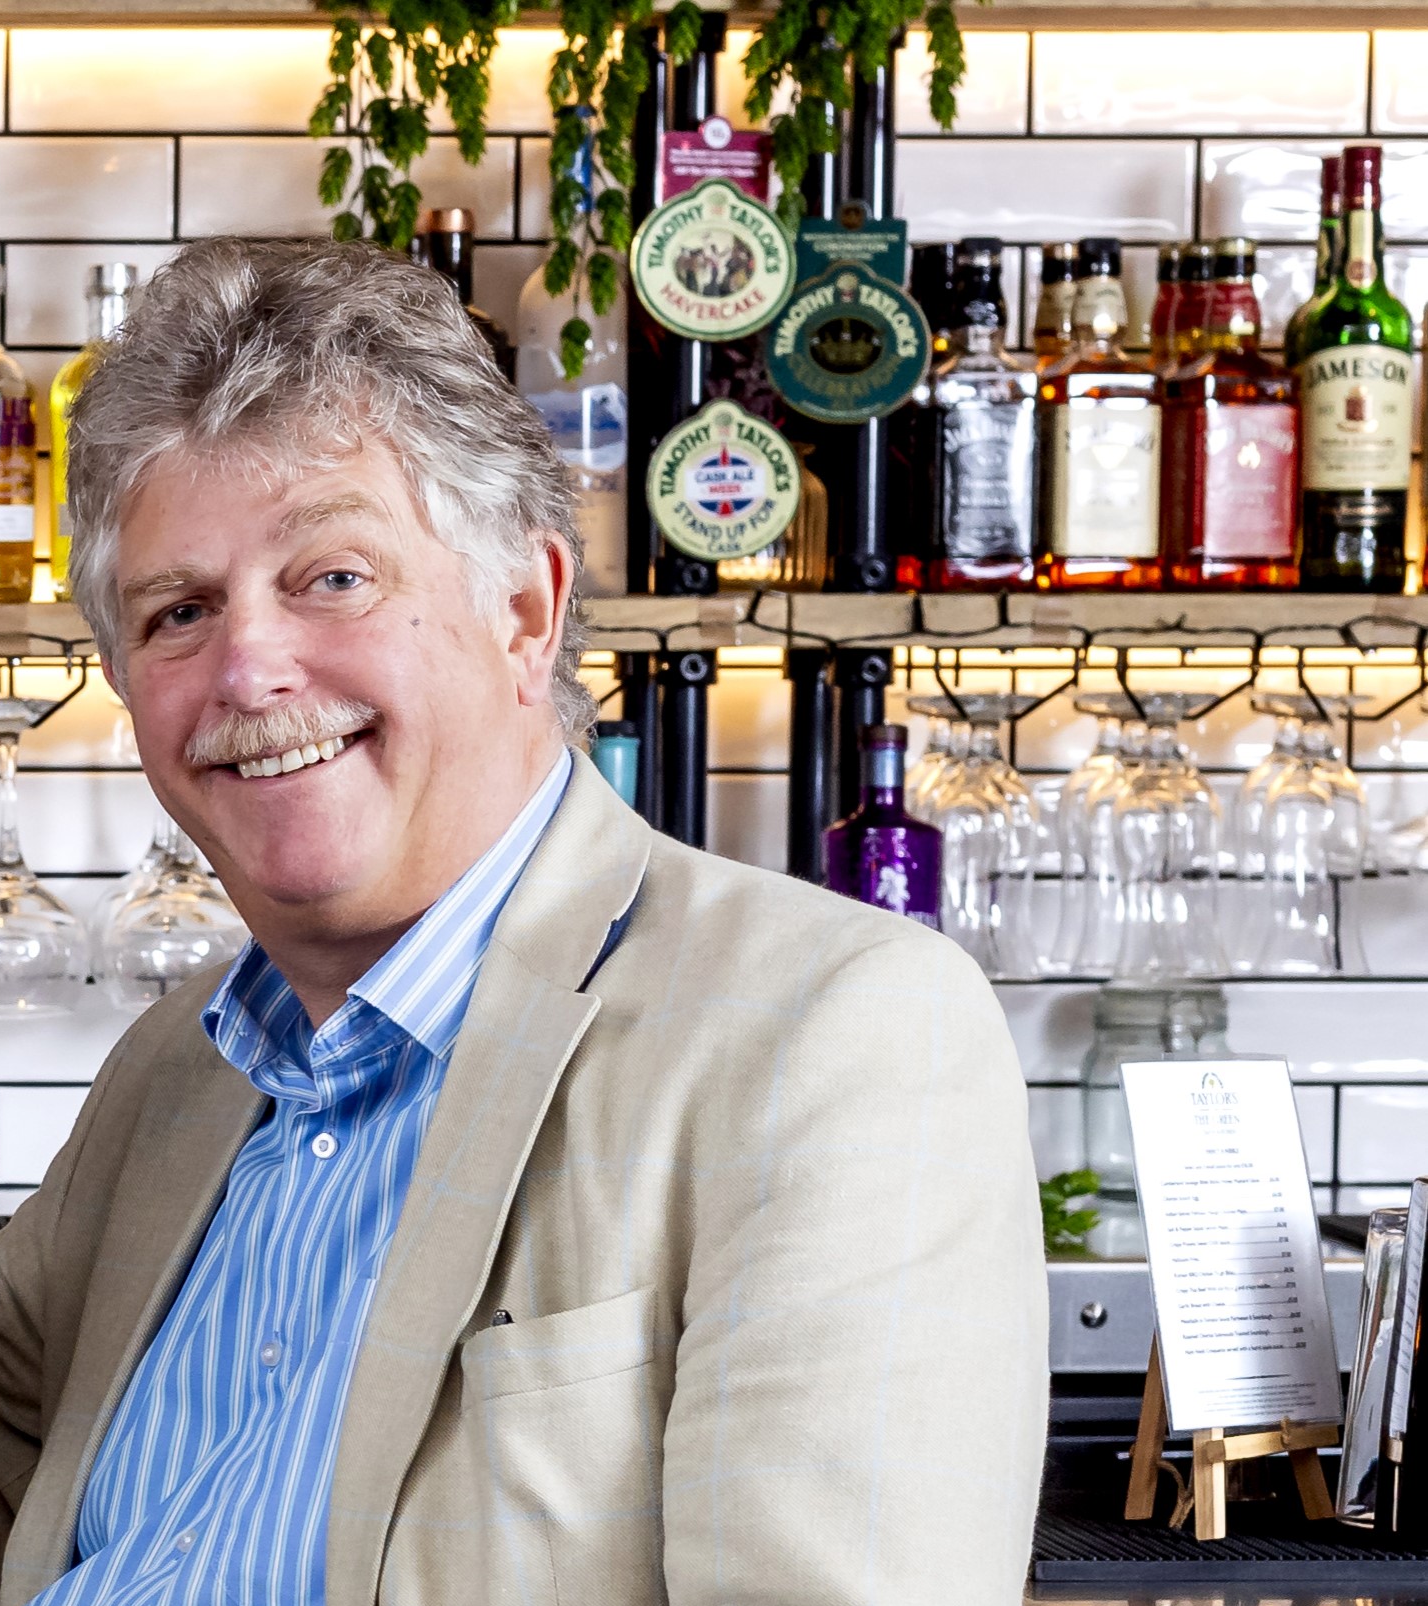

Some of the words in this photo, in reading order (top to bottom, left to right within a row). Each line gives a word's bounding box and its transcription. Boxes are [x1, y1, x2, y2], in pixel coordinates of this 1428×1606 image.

[660, 282, 766, 319] HAVERCAKE
[1307, 357, 1408, 388] JAMESON
[660, 425, 711, 498] TIMOTHY
